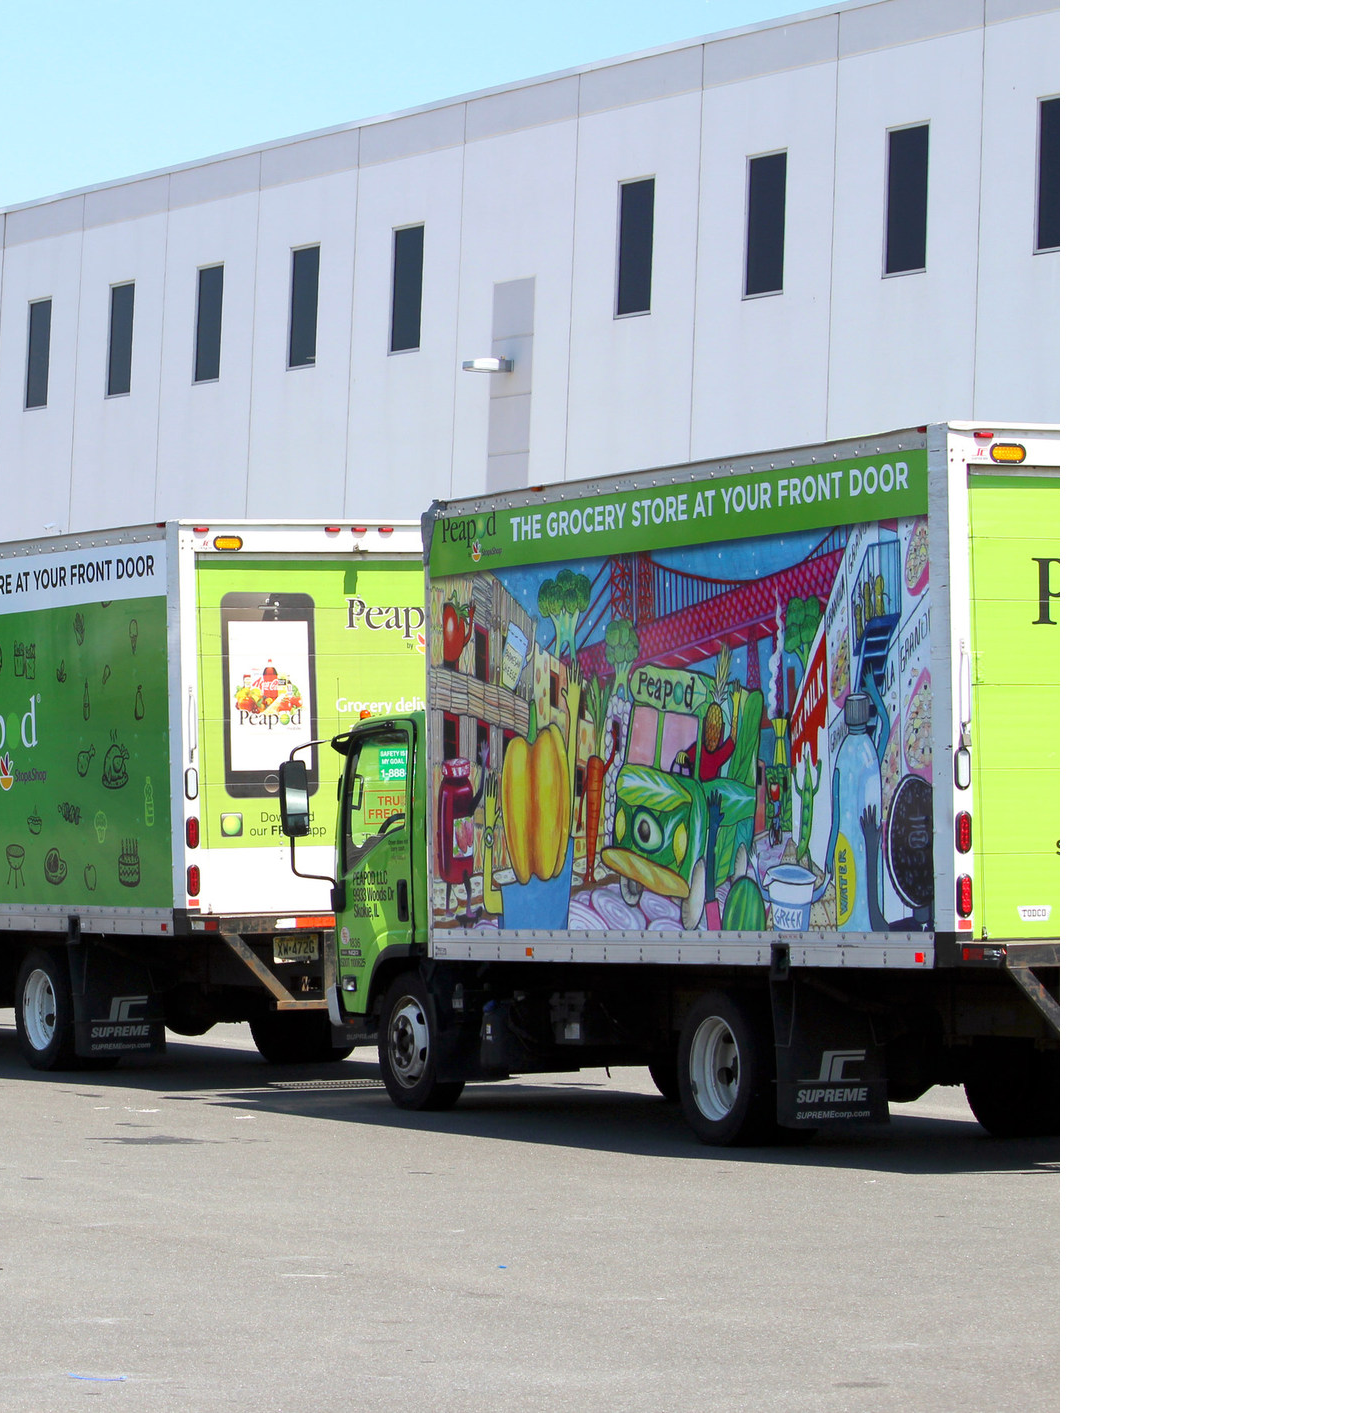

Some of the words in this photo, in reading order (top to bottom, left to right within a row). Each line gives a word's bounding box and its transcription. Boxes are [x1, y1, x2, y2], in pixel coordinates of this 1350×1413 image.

[510, 514, 542, 542] THE
[546, 503, 627, 538] GROCERY
[631, 494, 688, 527] STORE
[693, 490, 716, 518] AT
[721, 482, 772, 514] YOUR
[778, 471, 843, 507] FRONT
[849, 461, 909, 497] DOOR
[442, 511, 497, 548] Peapod
[15, 572, 30, 593] AT
[33, 566, 67, 590] YOUR
[70, 560, 112, 585] FRONT
[116, 555, 155, 580] DOOR
[406, 642, 414, 650] by
[636, 671, 696, 710] Peapod
[804, 661, 824, 722] MILK
[336, 697, 392, 714] Grocery
[239, 709, 302, 729] Peapod
[250, 826, 267, 836] our
[308, 826, 327, 839] app
[353, 871, 376, 886] PEAPOD
[376, 870, 388, 885] LLC
[838, 848, 849, 916] WATER
[367, 886, 387, 901] Woods
[387, 886, 395, 901] Dr
[773, 907, 802, 930] GREEK
[1021, 908, 1047, 918] TODCO
[91, 1025, 150, 1038] SUPREME
[796, 1087, 868, 1104] SUPREME
[796, 1110, 871, 1120] SUPREMEcorp.com
